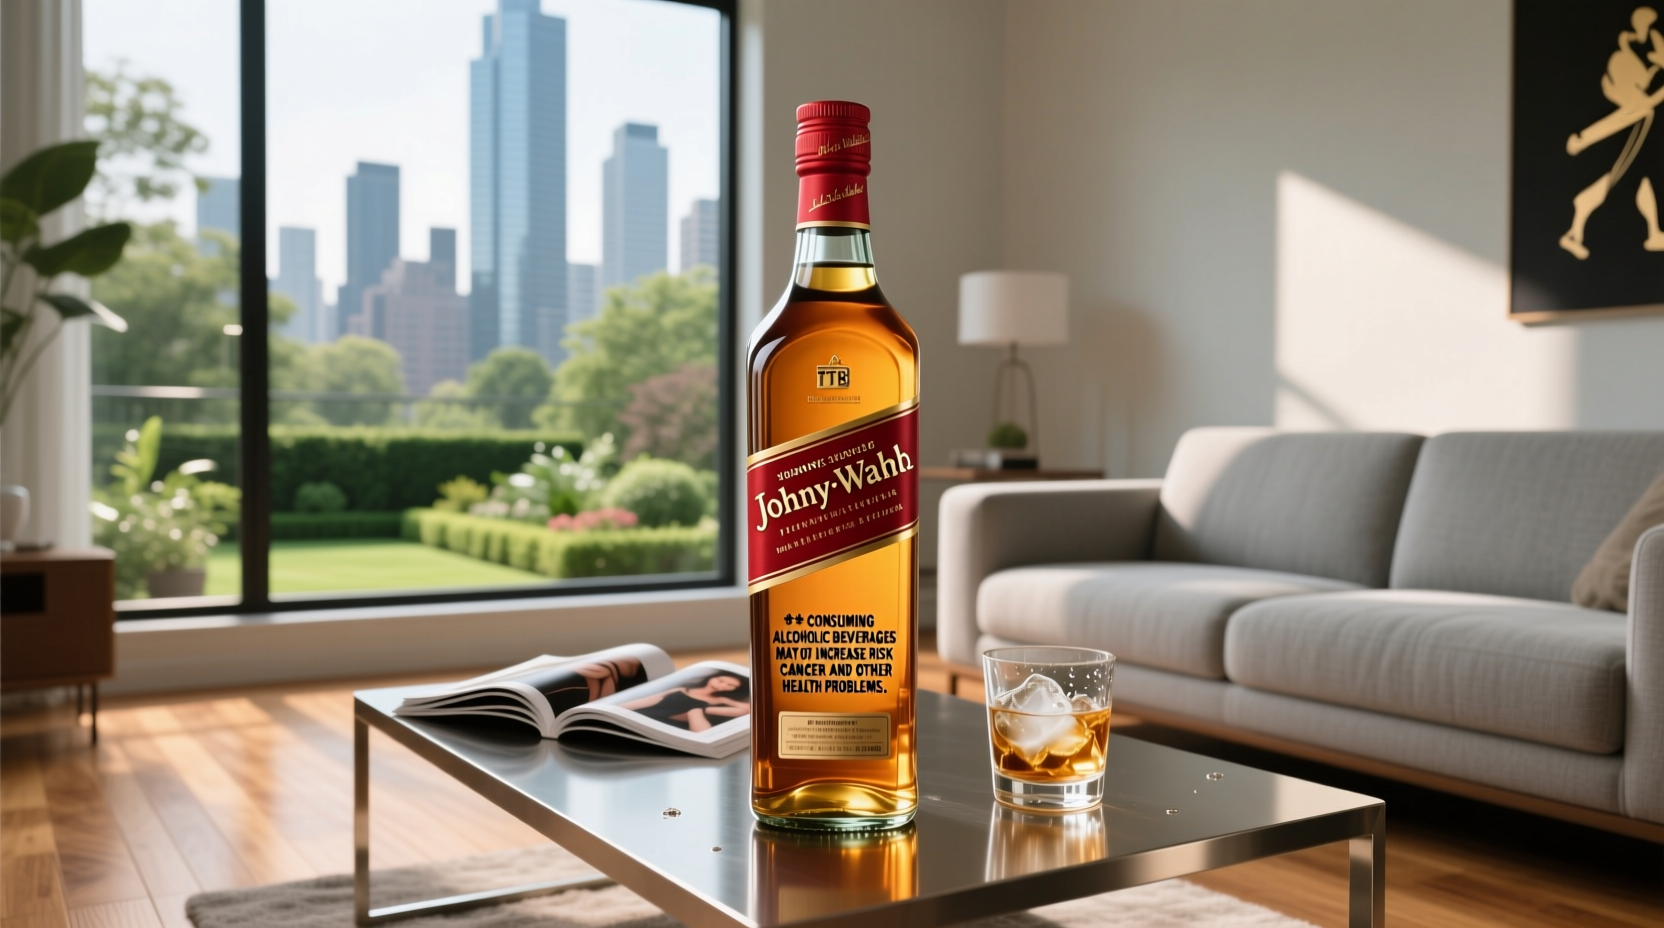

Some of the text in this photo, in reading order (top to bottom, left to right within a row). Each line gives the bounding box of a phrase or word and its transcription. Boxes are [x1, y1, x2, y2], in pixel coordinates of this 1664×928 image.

[807, 614, 875, 627] CONSUMING
[772, 630, 897, 644] ALCOHOLIC BEVERAGES
[775, 646, 799, 660] MAY
[815, 647, 866, 660] INCREASE
[869, 647, 893, 660] RISK
[780, 663, 892, 677] CANCER AND OTHER
[825, 679, 887, 693] PROBLEMS.
